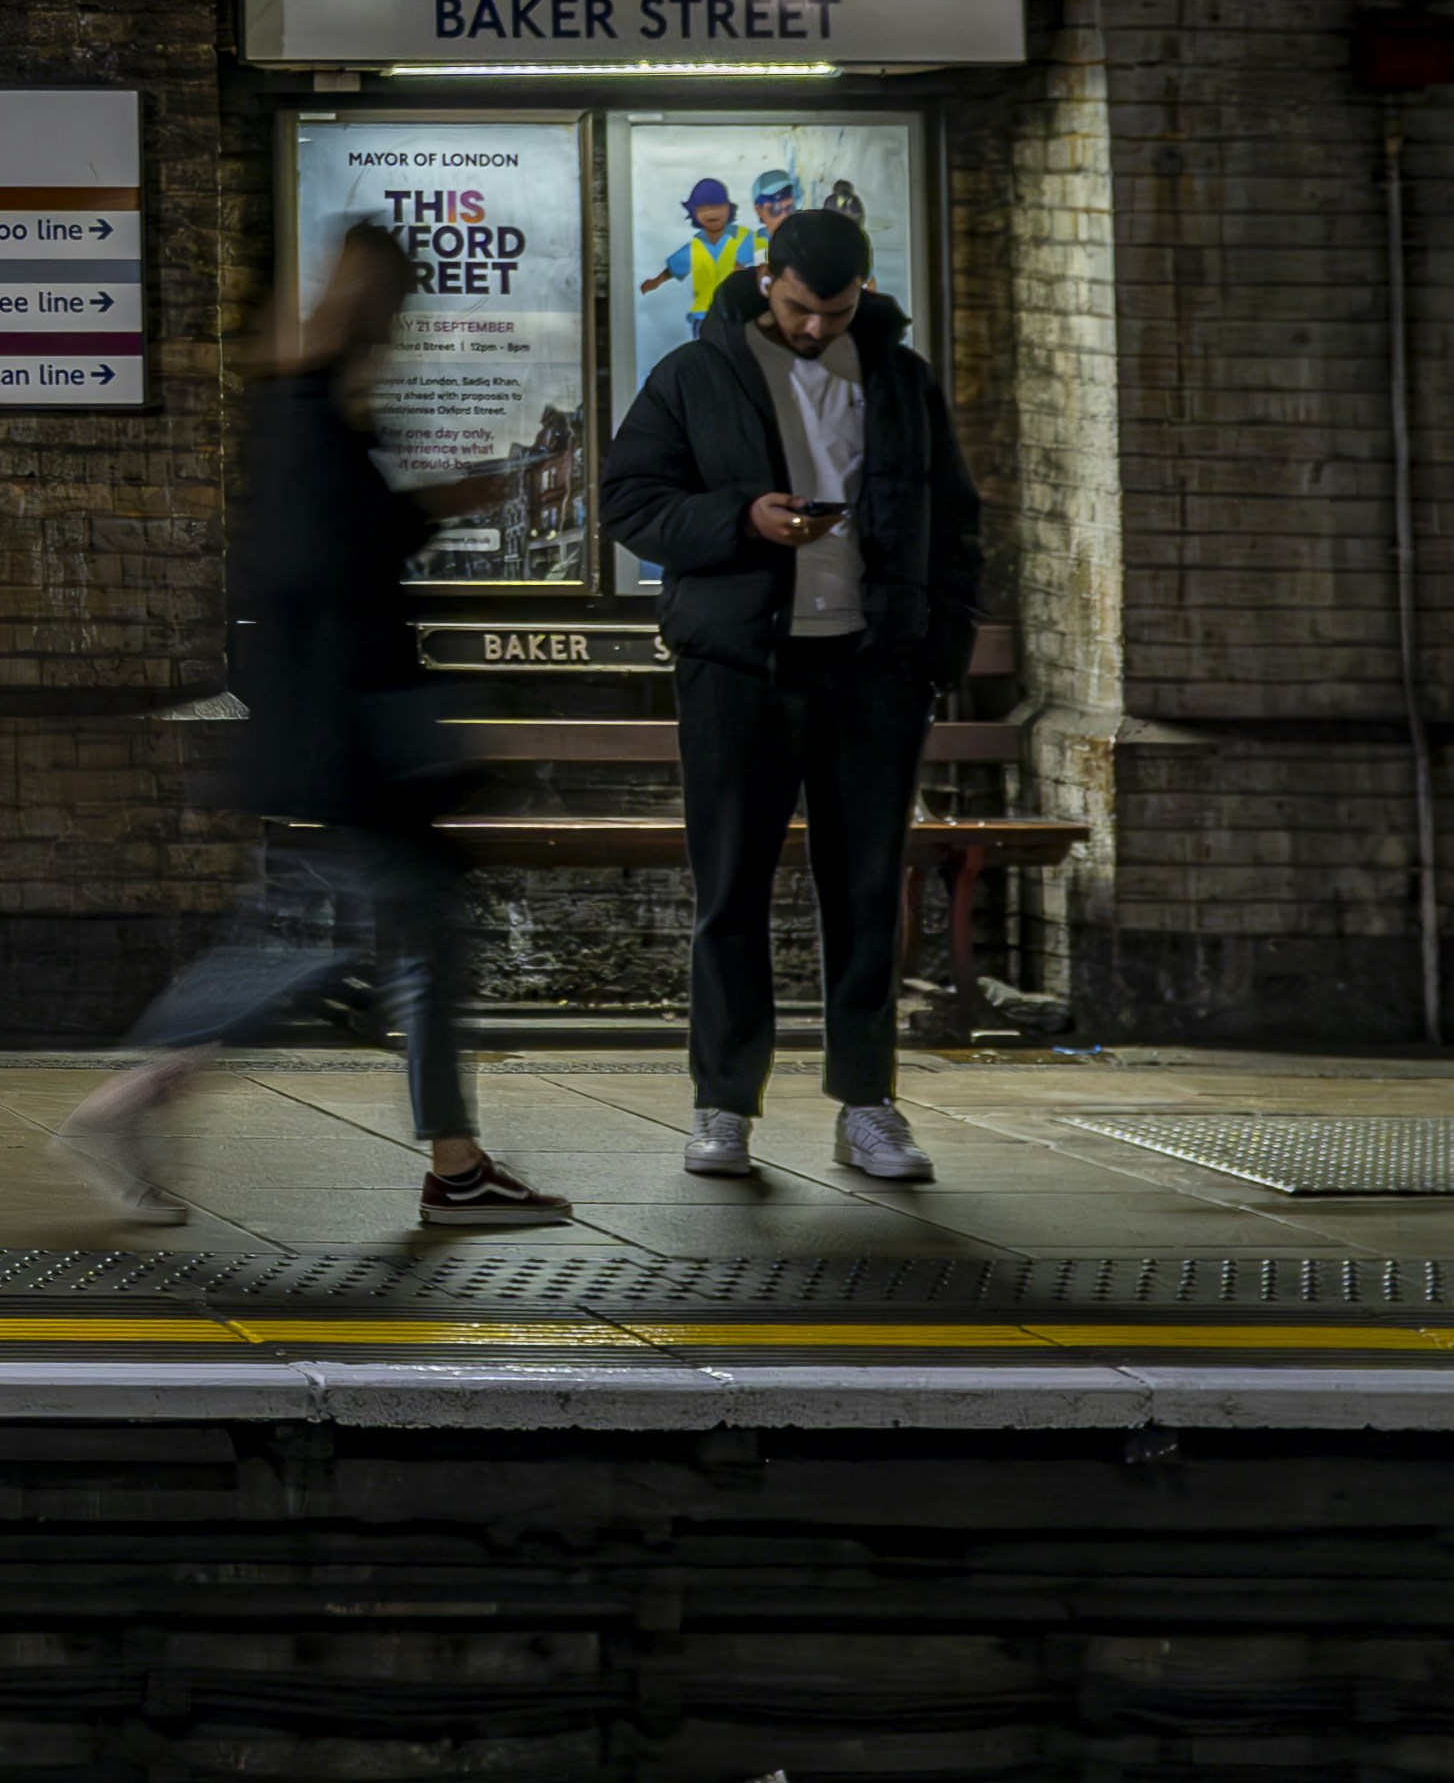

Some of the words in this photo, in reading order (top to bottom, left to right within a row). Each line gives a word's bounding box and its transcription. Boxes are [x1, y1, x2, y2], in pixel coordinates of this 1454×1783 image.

[348, 152, 409, 166] MAYOR
[414, 153, 437, 166] OF
[442, 153, 518, 167] LONDON
[384, 190, 486, 224] THIS
[38, 218, 82, 240] line
[392, 225, 526, 259] FORD
[410, 261, 518, 295] REET
[39, 291, 84, 313] line
[416, 321, 430, 333] 21
[433, 321, 515, 333] SEPTEMBER
[40, 364, 84, 385] line
[435, 427, 460, 441] day
[484, 634, 590, 660] BAKER
